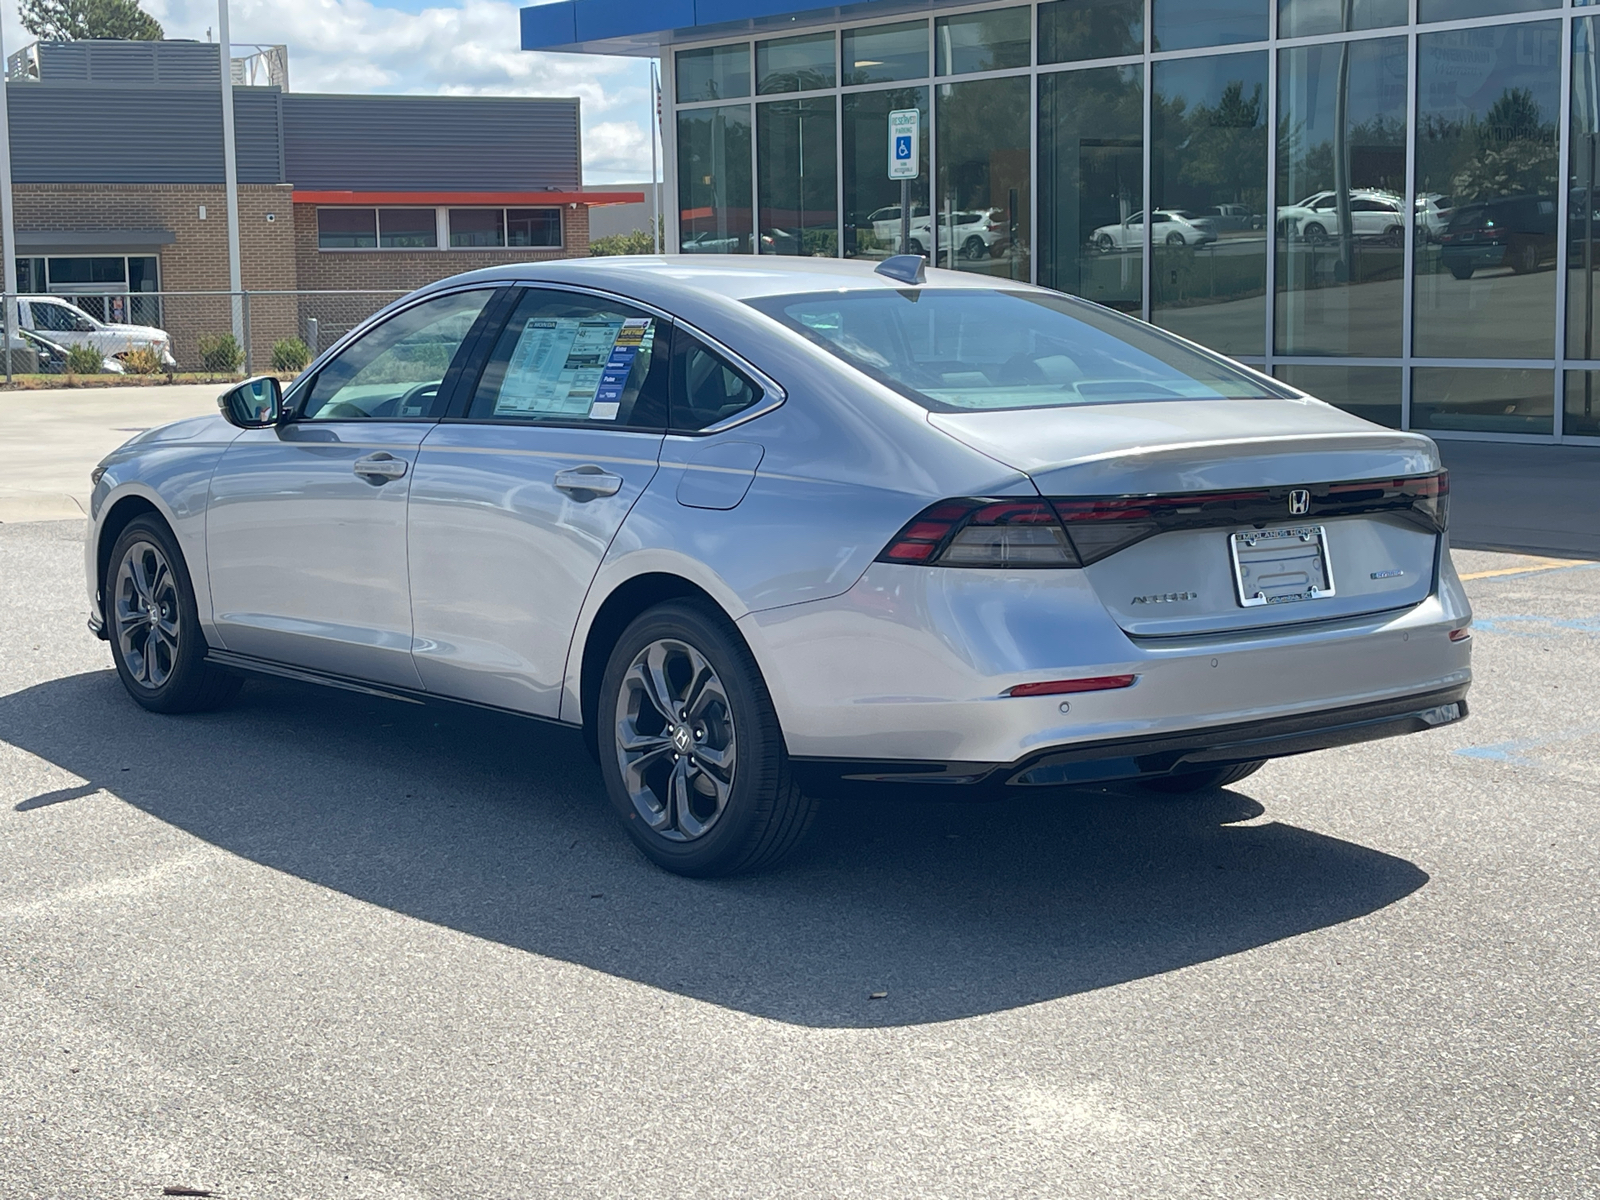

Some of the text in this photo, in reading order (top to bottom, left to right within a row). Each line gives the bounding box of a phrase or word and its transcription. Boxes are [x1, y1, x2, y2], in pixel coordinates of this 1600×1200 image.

[891, 115, 917, 126] RESERVED
[895, 126, 912, 135] PARKING
[1243, 526, 1320, 541] MIDLANDS HONDA
